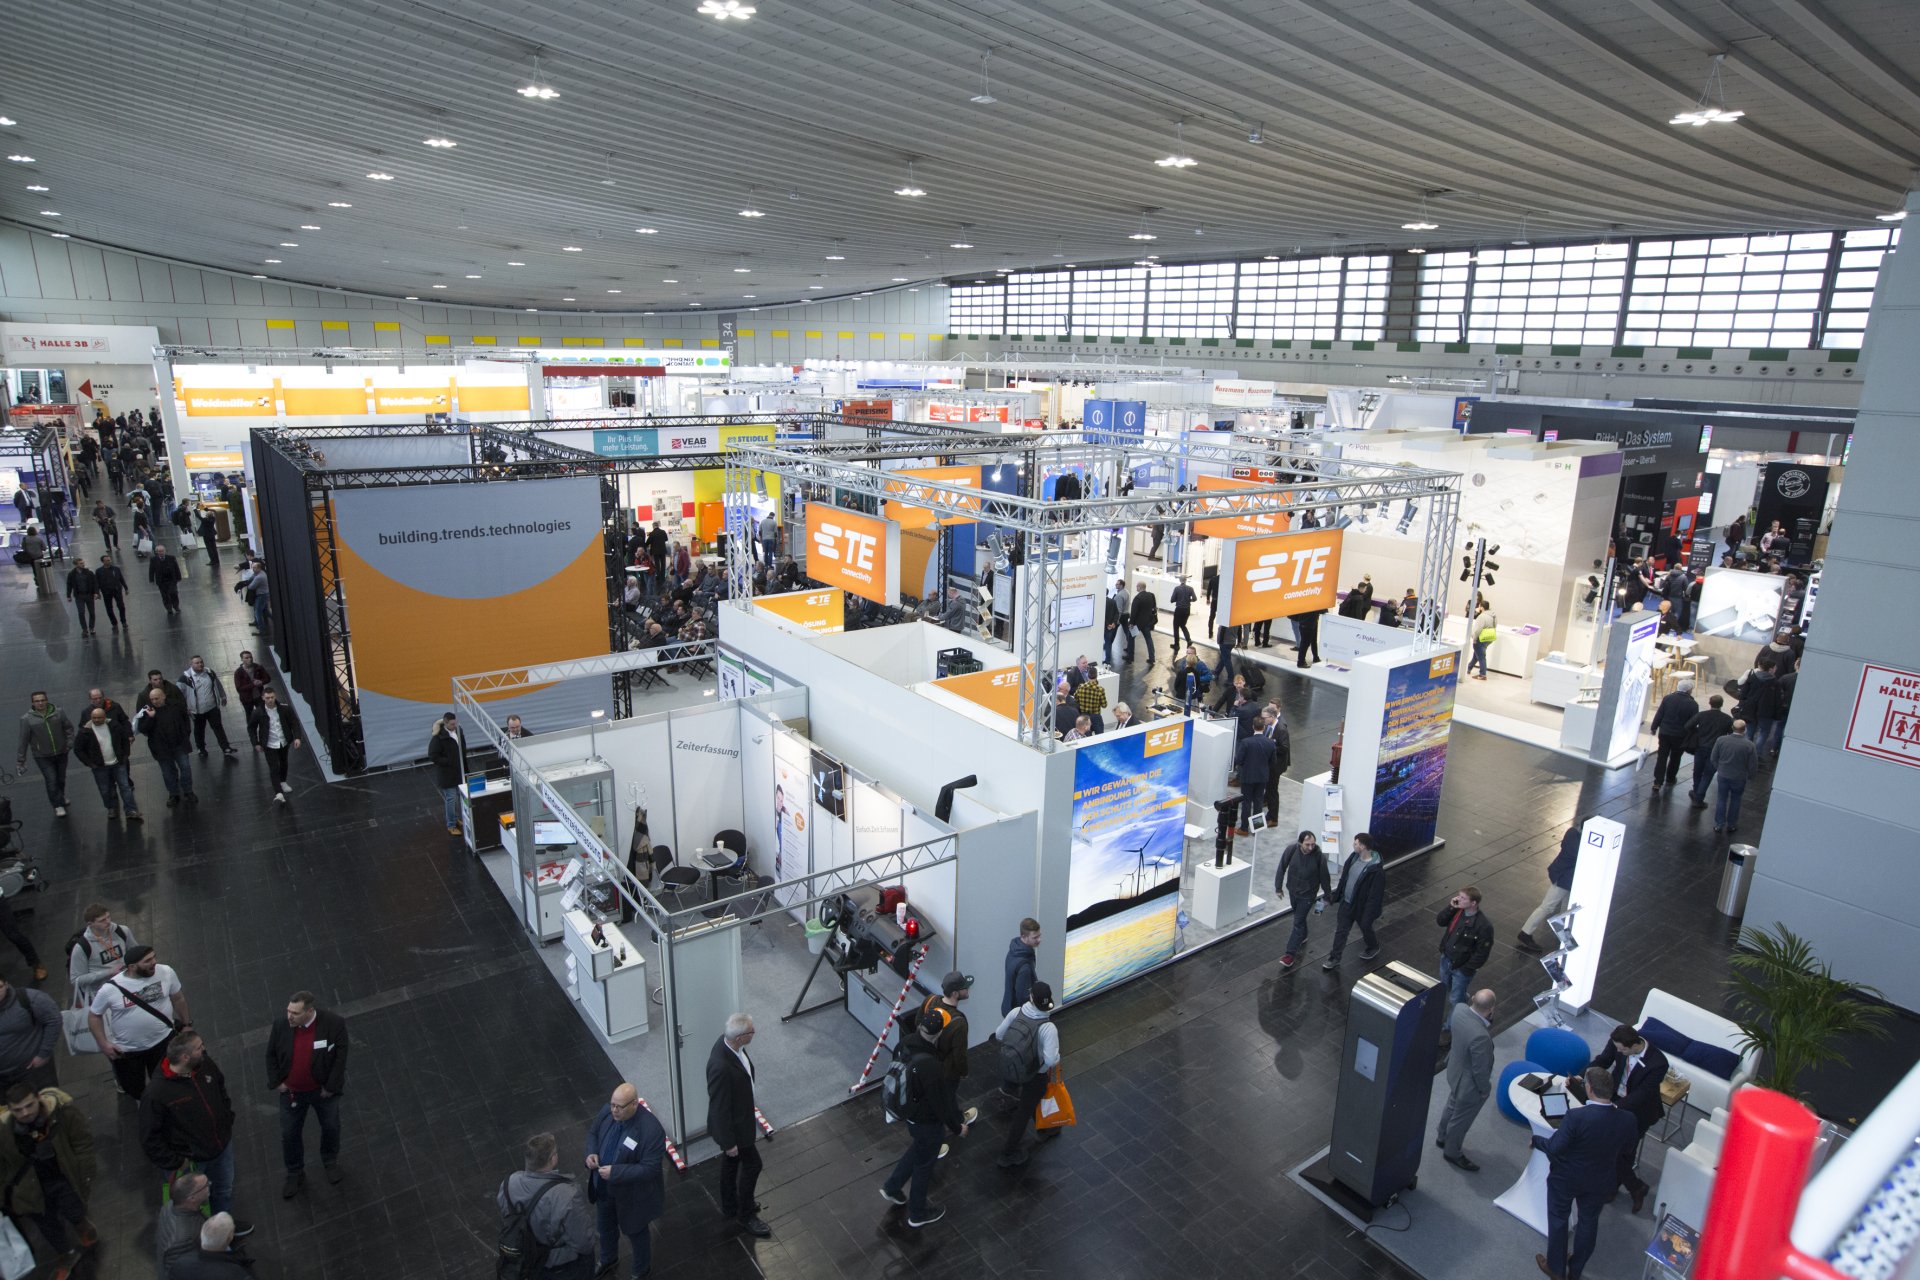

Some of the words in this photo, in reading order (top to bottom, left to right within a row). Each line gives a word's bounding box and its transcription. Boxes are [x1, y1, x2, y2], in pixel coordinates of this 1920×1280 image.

[723, 322, 734, 338] 34
[39, 340, 71, 348] HALLE
[74, 340, 89, 348] 3B
[682, 437, 707, 446] VEAB
[737, 435, 769, 443] STEIDELE
[1625, 431, 1642, 446] Das
[1642, 429, 1673, 447] System.
[379, 519, 572, 546] building.trends.technologies
[844, 529, 877, 571] TE
[1290, 546, 1332, 587] TE
[841, 567, 872, 585] connectivity
[1283, 586, 1322, 600] connectivity
[1441, 657, 1452, 668] TE
[1006, 671, 1020, 683] TE
[1892, 676, 1920, 690] AUF
[1164, 728, 1181, 743] TE
[676, 740, 740, 759] Zeiterfassung
[1083, 786, 1100, 798] WIR
